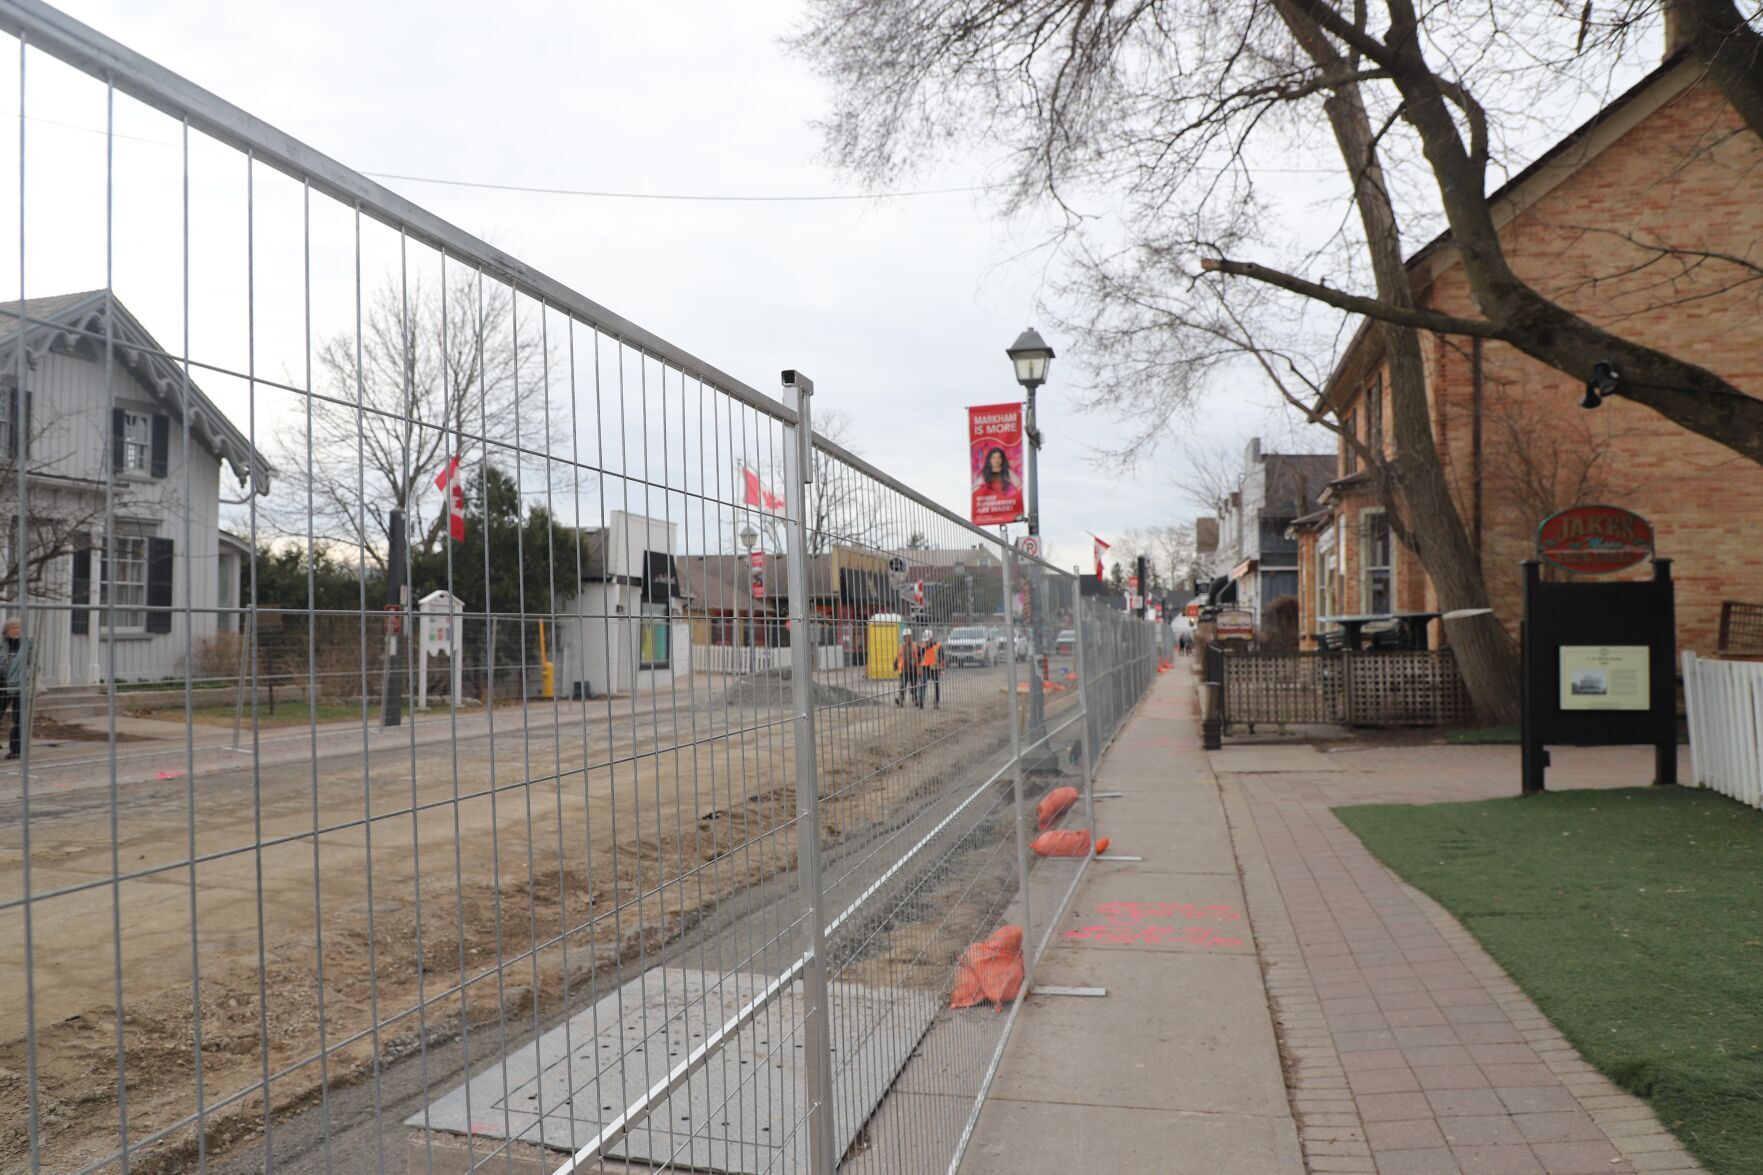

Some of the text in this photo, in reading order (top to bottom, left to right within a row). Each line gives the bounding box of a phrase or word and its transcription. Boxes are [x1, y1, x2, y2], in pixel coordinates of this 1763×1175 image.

[974, 413, 1017, 425] MARKHAM
[974, 423, 1017, 435] IS MORE
